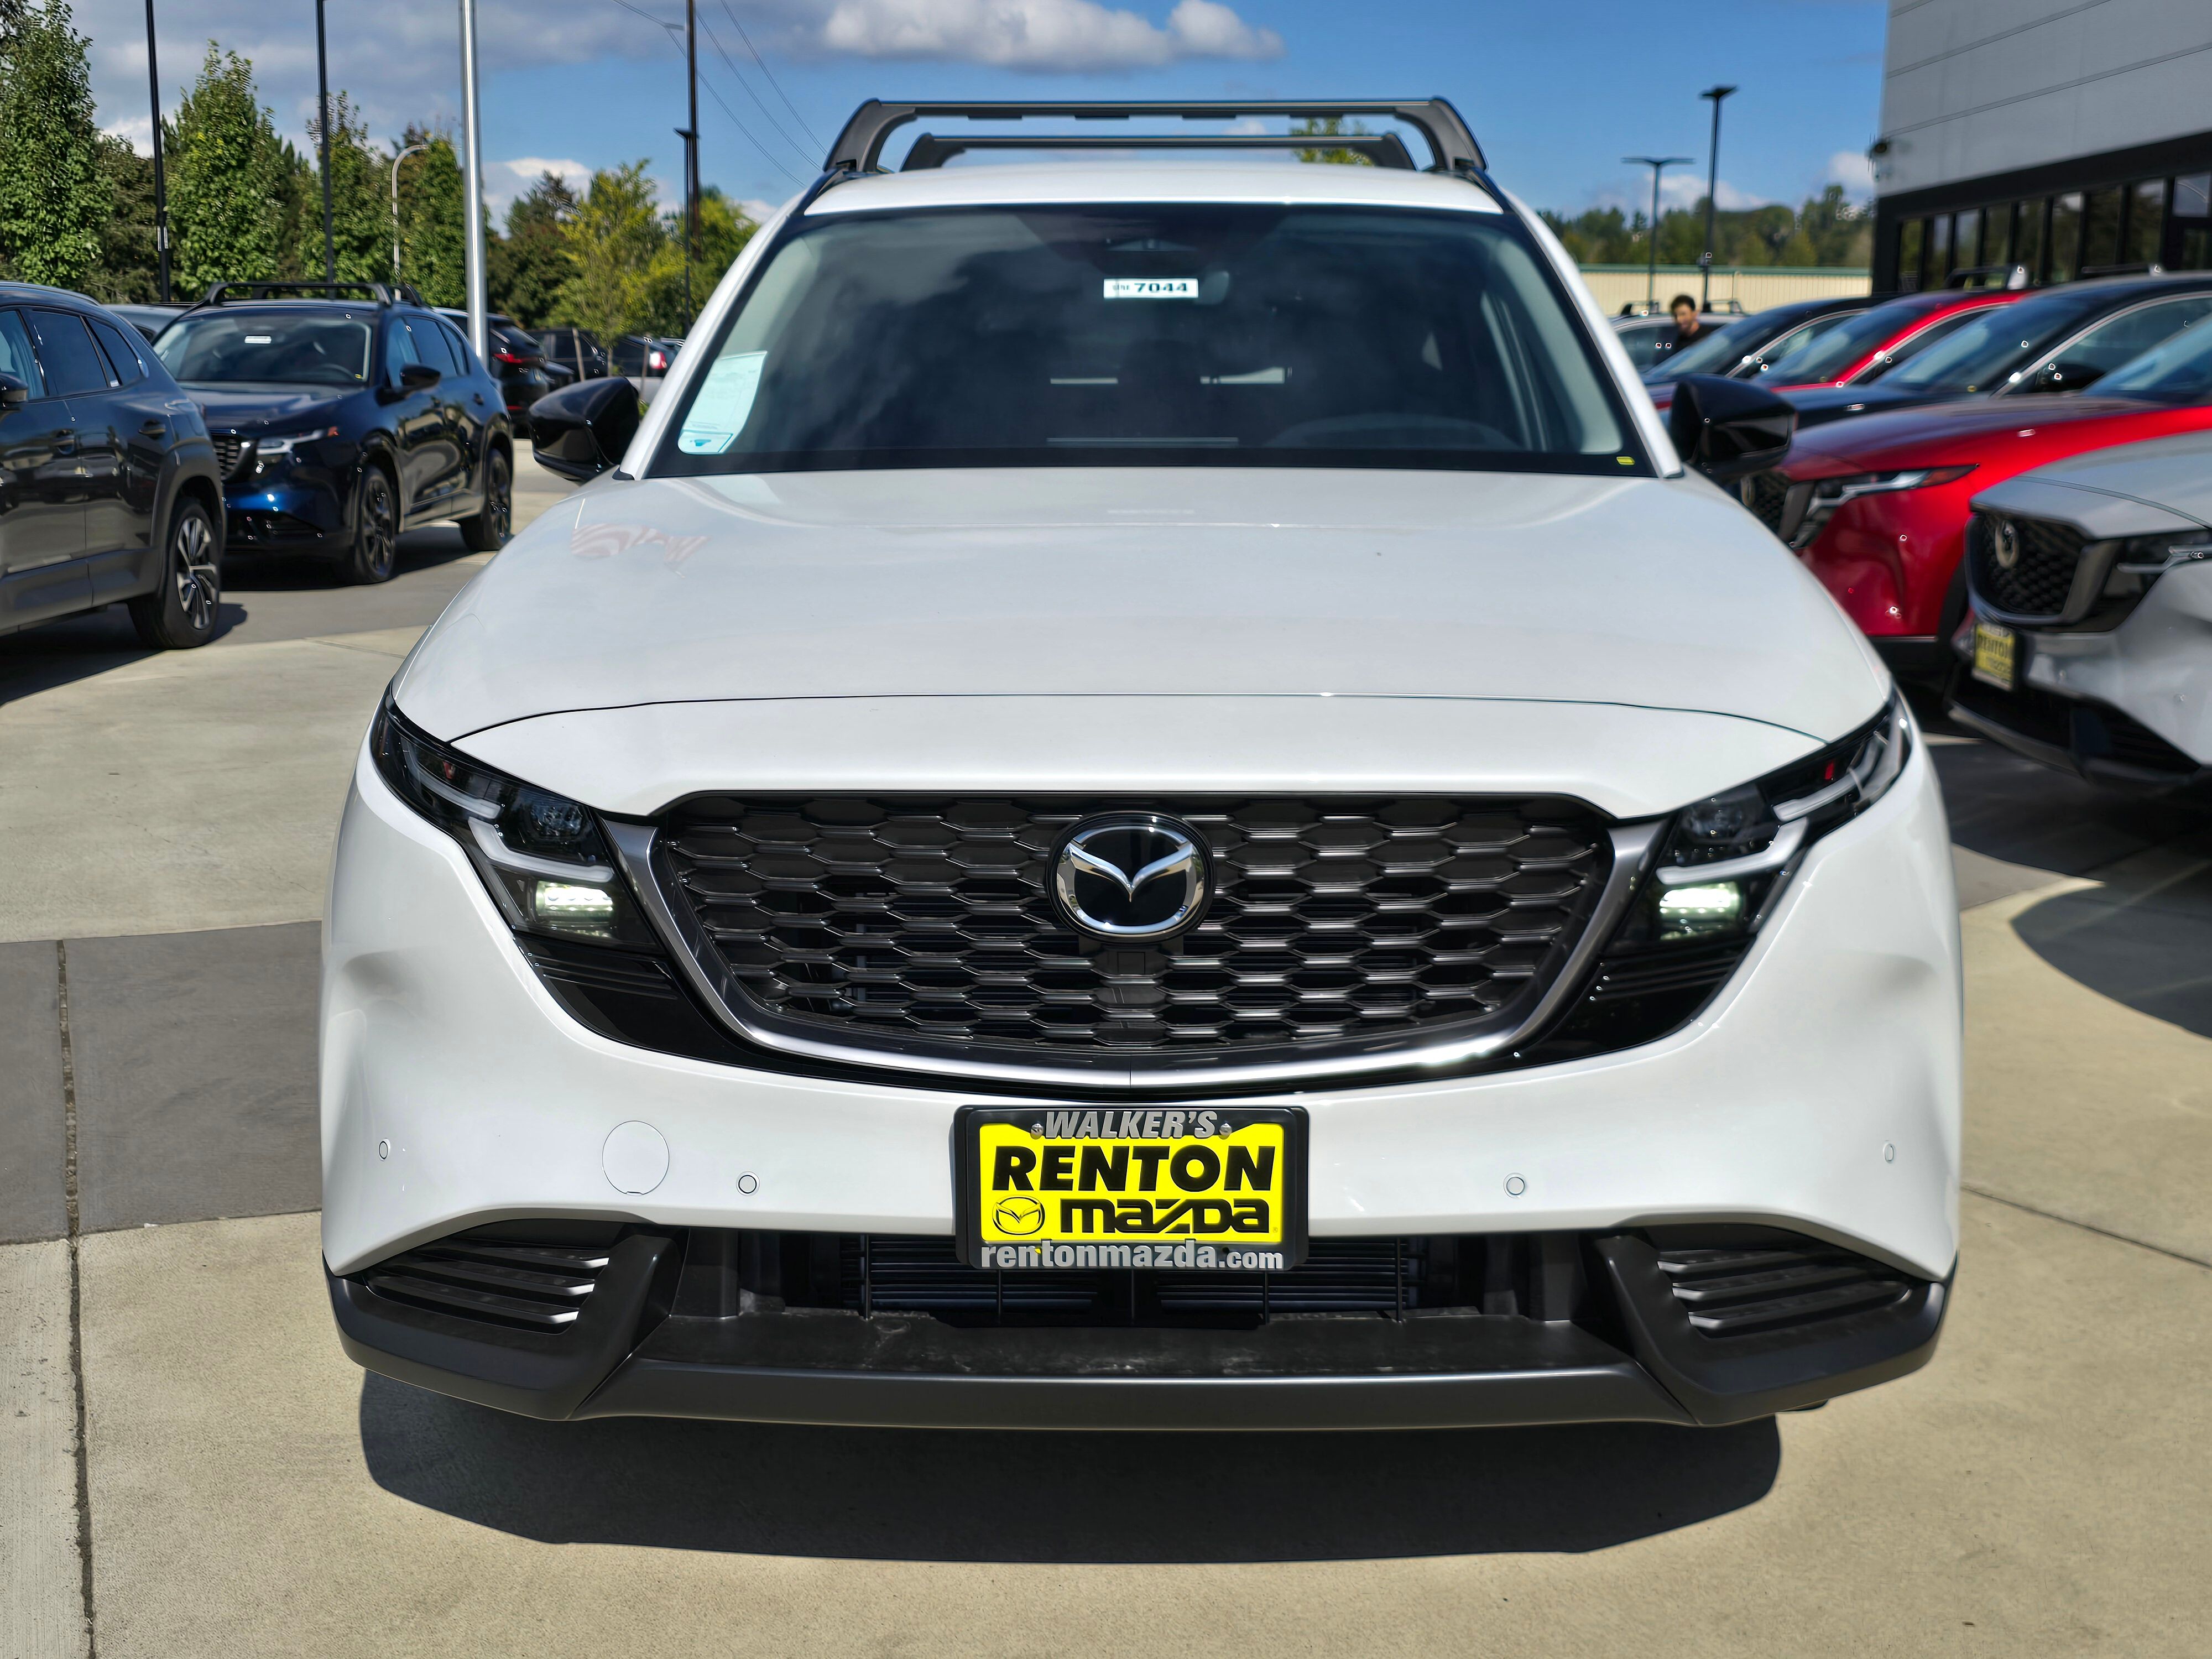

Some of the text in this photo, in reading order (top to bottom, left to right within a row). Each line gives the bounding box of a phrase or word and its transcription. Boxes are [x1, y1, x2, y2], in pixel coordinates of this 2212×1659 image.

[1134, 283, 1187, 293] 7044
[1045, 1110, 1218, 1139] WALKER'S
[992, 1144, 1276, 1192] RENTON
[1060, 1198, 1270, 1234] mazda
[981, 1238, 1283, 1269] rentonmazda.com
